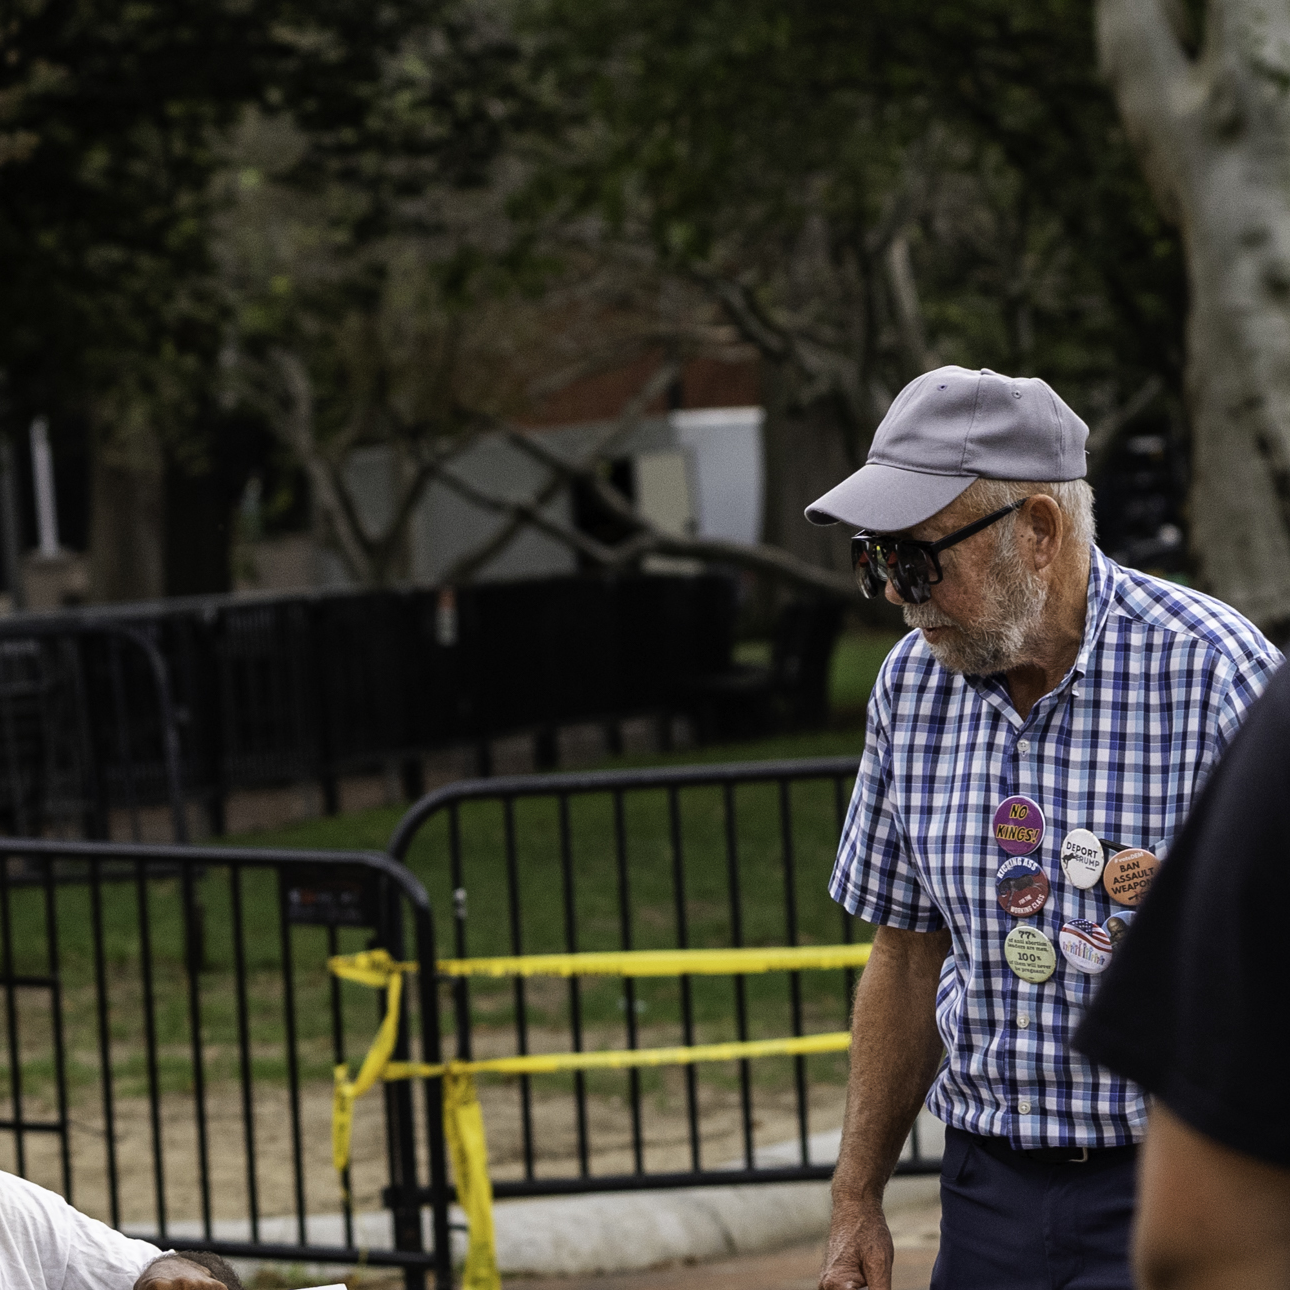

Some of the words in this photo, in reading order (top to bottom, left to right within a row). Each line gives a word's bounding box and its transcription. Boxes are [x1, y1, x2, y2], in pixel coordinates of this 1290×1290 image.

[1009, 803, 1028, 819] NO
[996, 823, 1040, 844] KINGS!
[1066, 841, 1098, 859] DEPORT
[997, 857, 1022, 879] KICKING
[1023, 857, 1038, 871] ASS
[1113, 867, 1155, 885] ASSAULT
[1119, 861, 1140, 873] BAN
[1111, 878, 1152, 895] WEAPON
[1010, 905, 1033, 914] WORKING
[1031, 893, 1045, 909] CLASS
